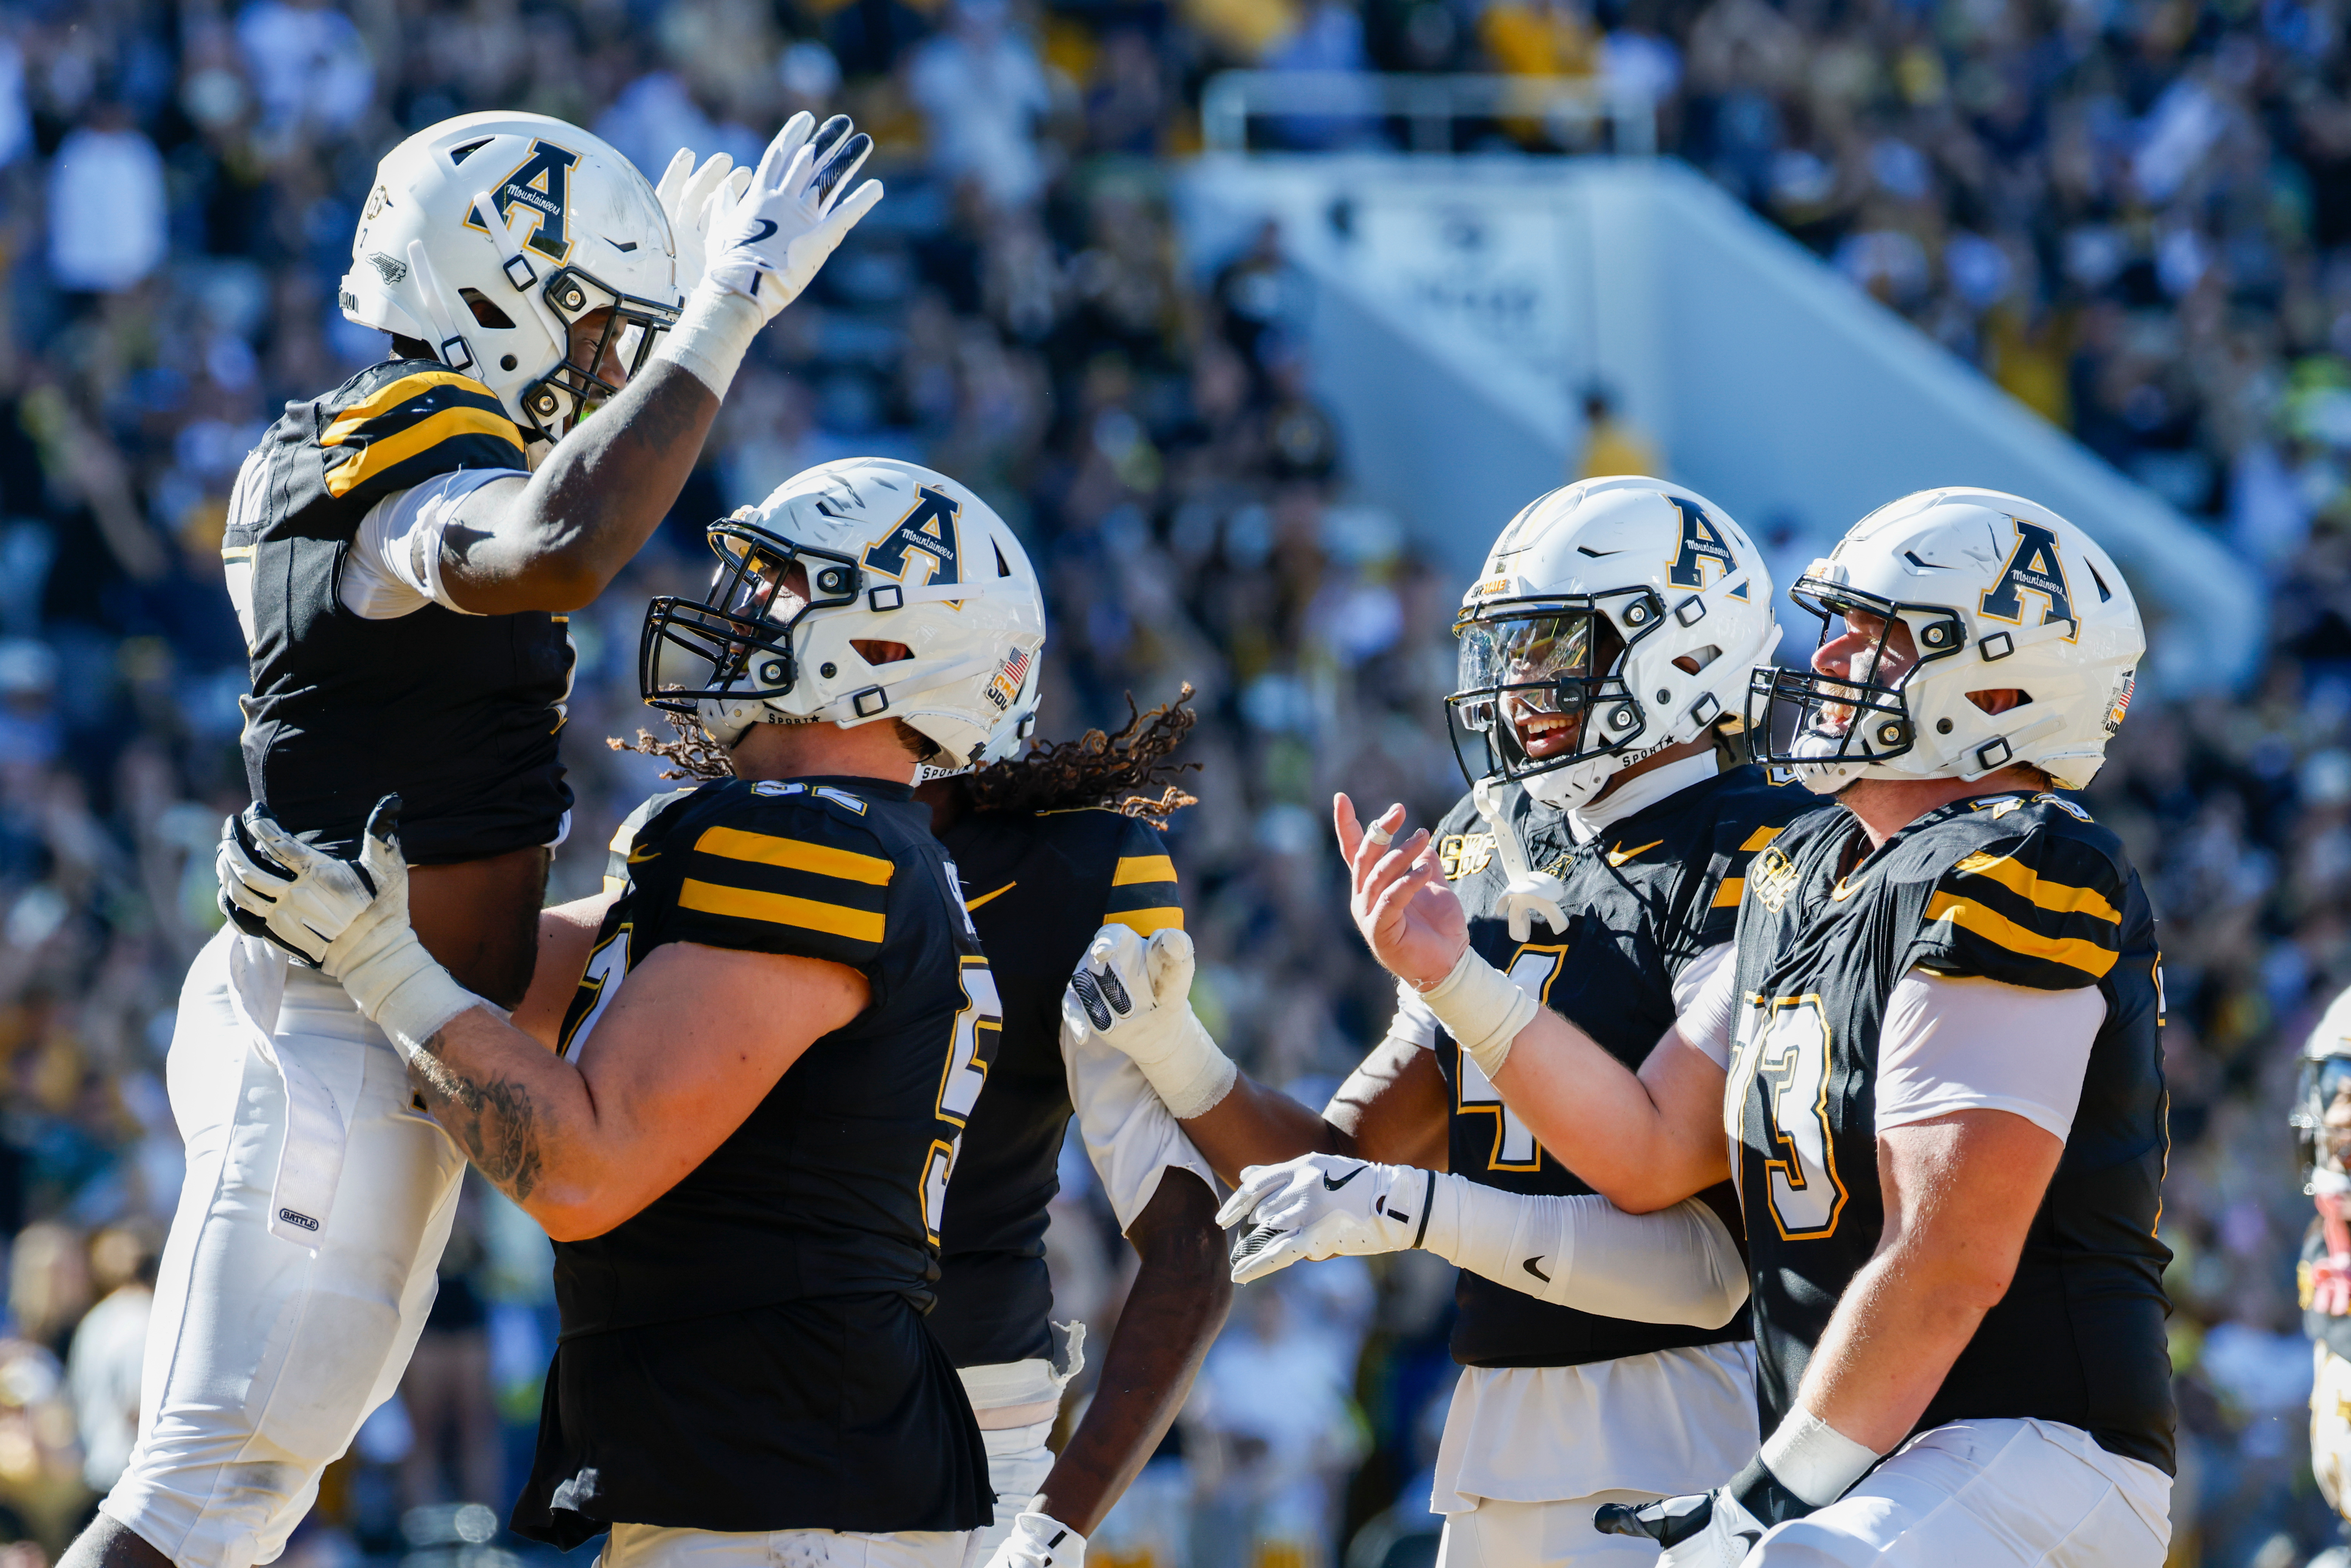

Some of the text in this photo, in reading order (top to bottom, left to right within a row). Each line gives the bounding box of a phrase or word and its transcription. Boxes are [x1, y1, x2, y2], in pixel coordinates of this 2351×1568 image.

[463, 138, 582, 267] A
[507, 184, 560, 215] Mountaineers
[858, 482, 962, 611] A
[901, 528, 954, 560] Mountaineers
[1666, 494, 1750, 603] A
[1685, 539, 1729, 558] Mountaineers
[1978, 518, 2081, 644] A
[2011, 569, 2063, 595] Mountaineers
[1622, 739, 1663, 768] SPORT
[283, 1211, 315, 1229] BATTLE
